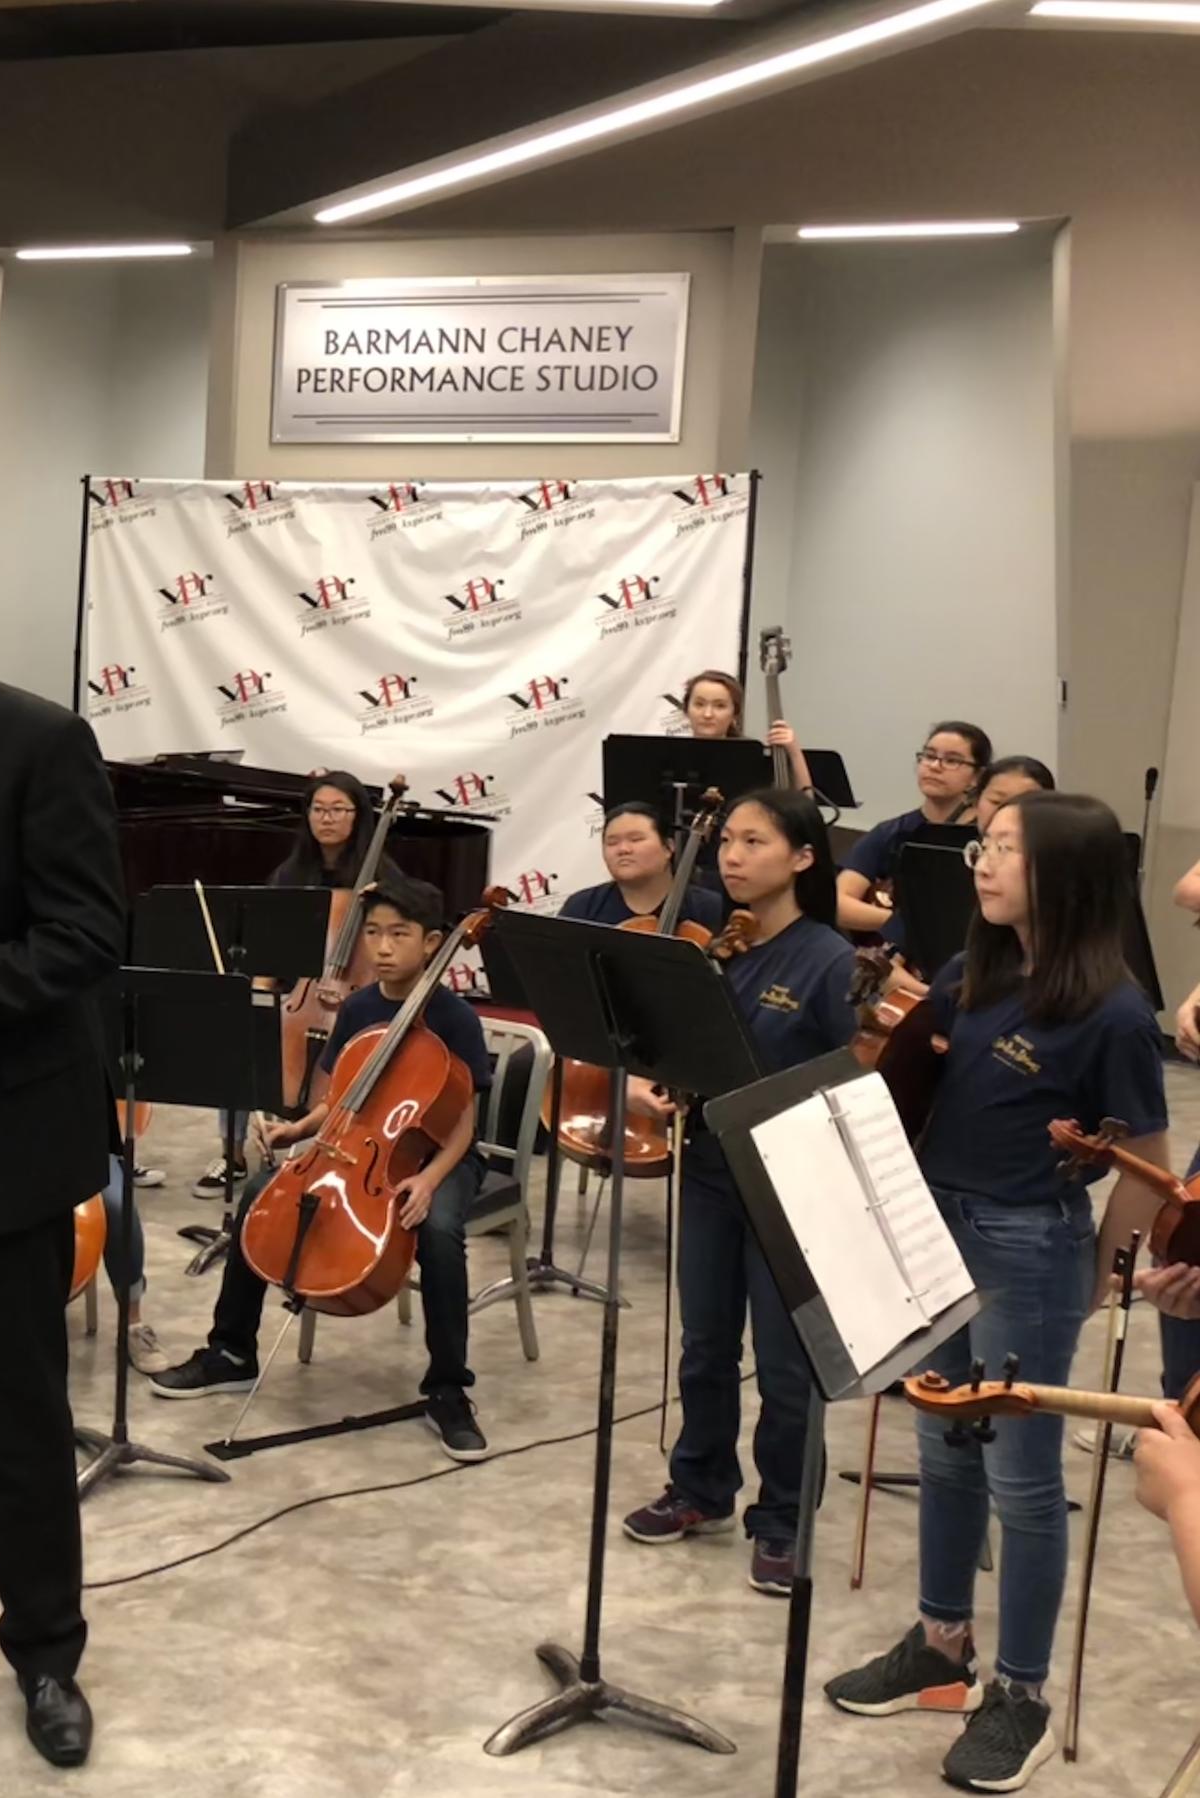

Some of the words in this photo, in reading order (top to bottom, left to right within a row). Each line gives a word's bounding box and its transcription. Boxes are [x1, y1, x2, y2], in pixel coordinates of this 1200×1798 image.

[324, 327, 486, 356] BARMANN
[498, 325, 634, 354] CHANEY
[297, 365, 525, 393] PERFORMANCE
[536, 364, 660, 392] STUDIO
